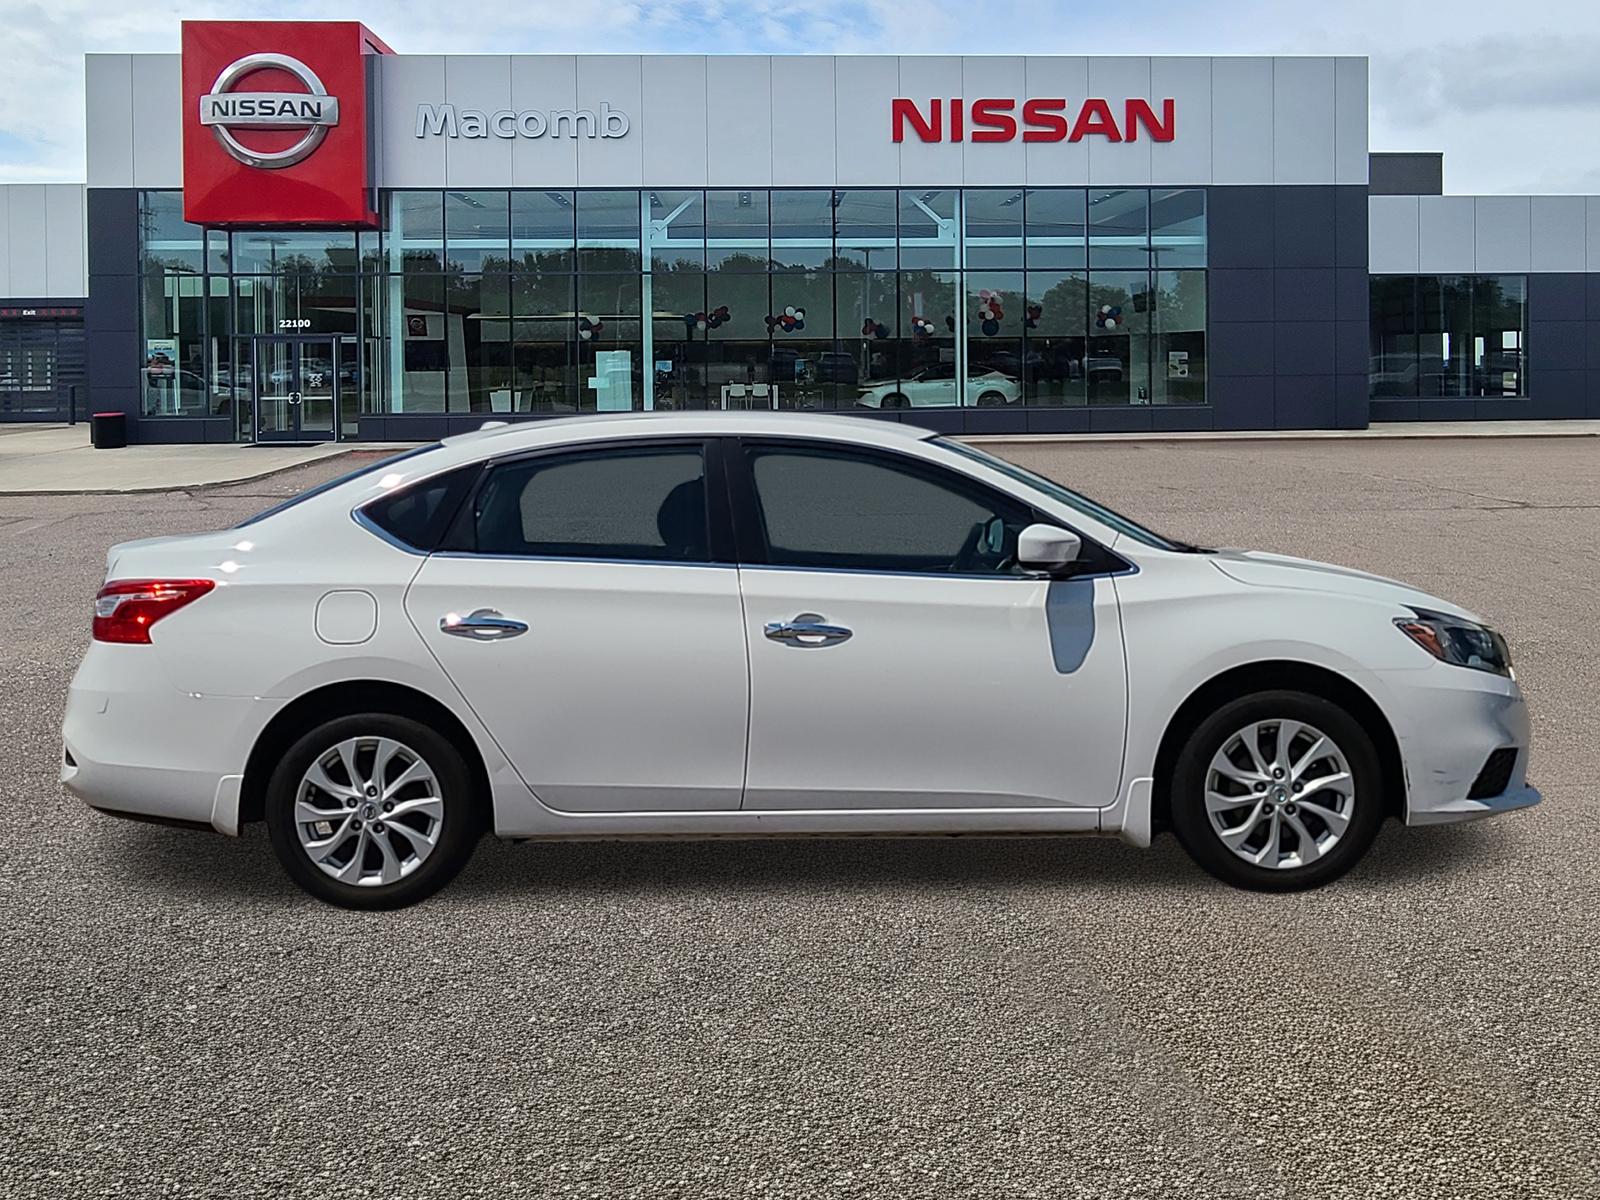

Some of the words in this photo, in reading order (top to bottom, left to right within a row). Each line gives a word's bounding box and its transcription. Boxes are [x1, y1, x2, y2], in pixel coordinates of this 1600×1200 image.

[212, 100, 321, 118] NISSAN
[415, 101, 630, 139] Macomb
[892, 98, 1175, 142] NISSAN
[279, 319, 311, 328] 22100
